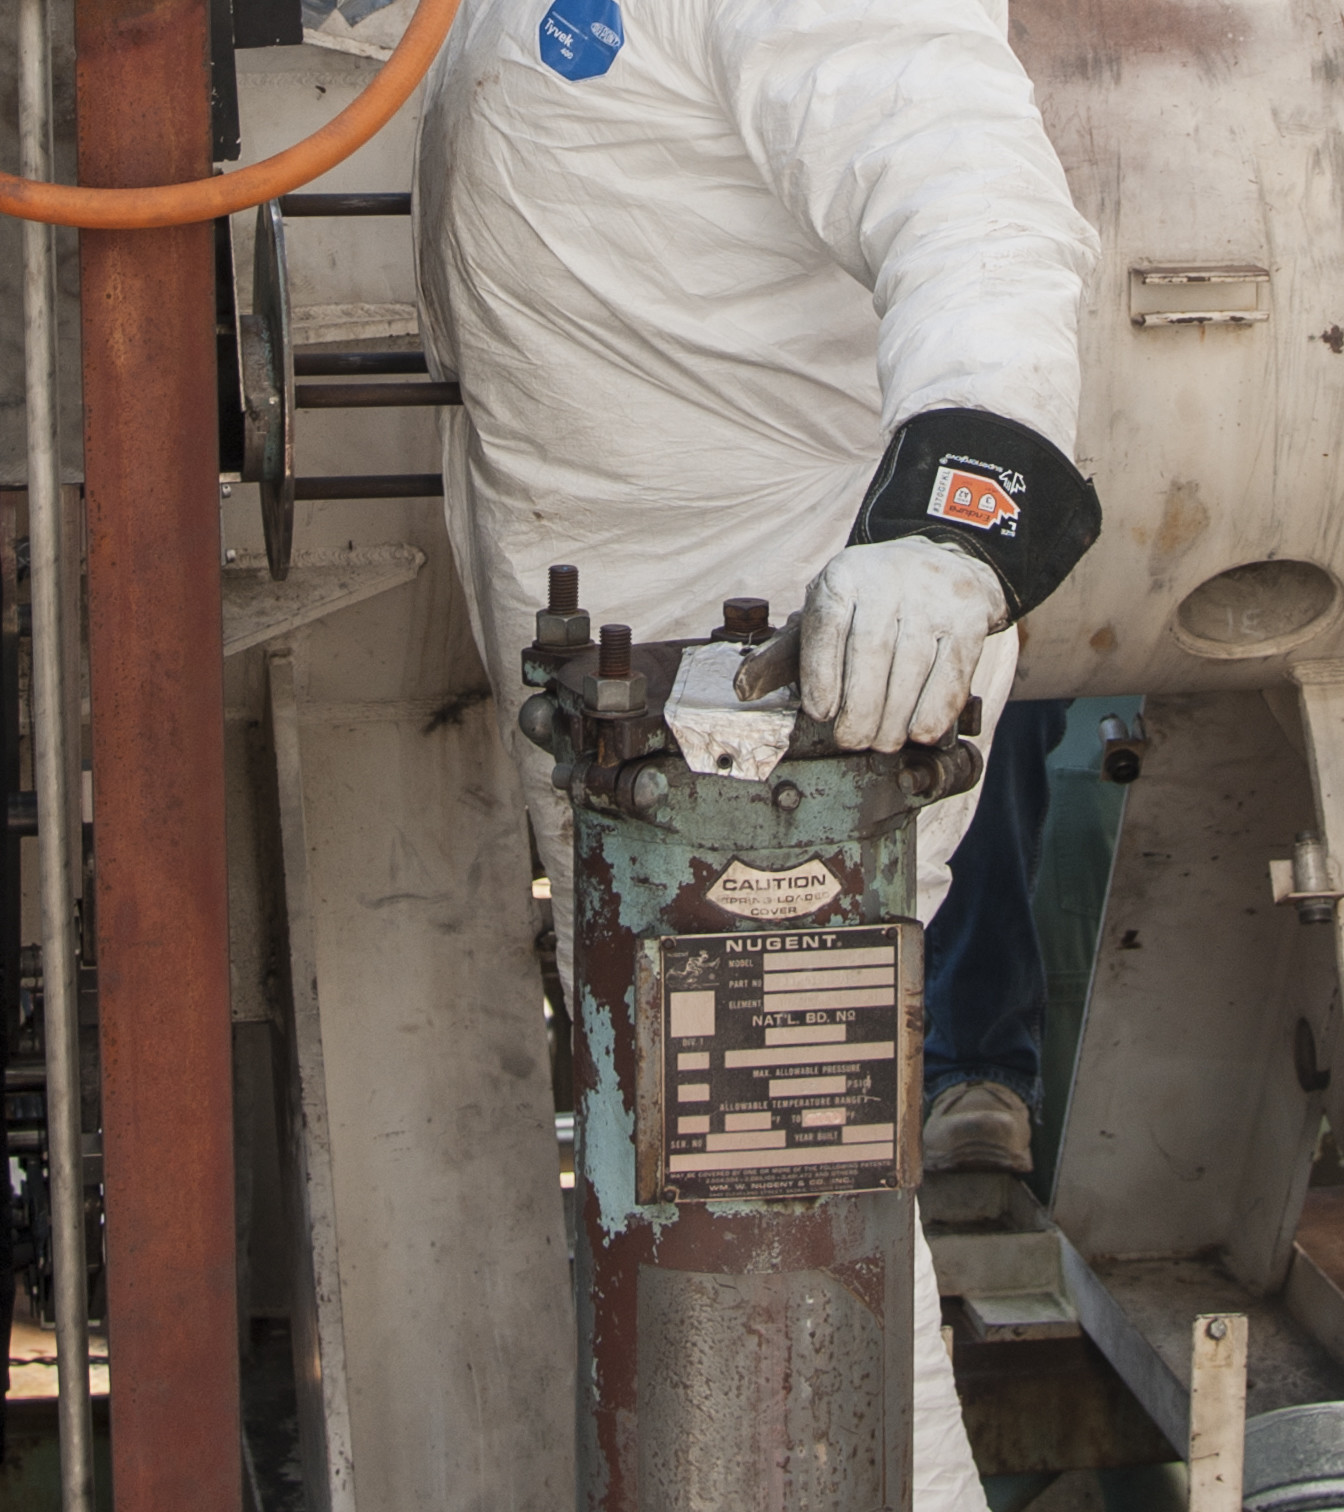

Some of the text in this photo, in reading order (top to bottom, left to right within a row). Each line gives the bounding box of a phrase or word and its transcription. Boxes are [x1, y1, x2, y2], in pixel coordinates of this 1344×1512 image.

[544, 17, 575, 48] Tyvek
[949, 505, 991, 522] Endura
[722, 874, 826, 891] CAUTION
[750, 906, 798, 917] COVER
[725, 934, 837, 953] NUGENT
[728, 959, 754, 969] MODEL
[728, 979, 748, 989] PART
[728, 999, 762, 1010] ELEMENT
[775, 1066, 820, 1077] ALLOWABLE
[822, 1063, 862, 1075] PRESSURE
[719, 1100, 769, 1112] ALLOWABLE
[772, 1097, 832, 1109] TEMPERATURE
[794, 1133, 814, 1143] YEAR
[750, 1179, 794, 1189] NUGENT
